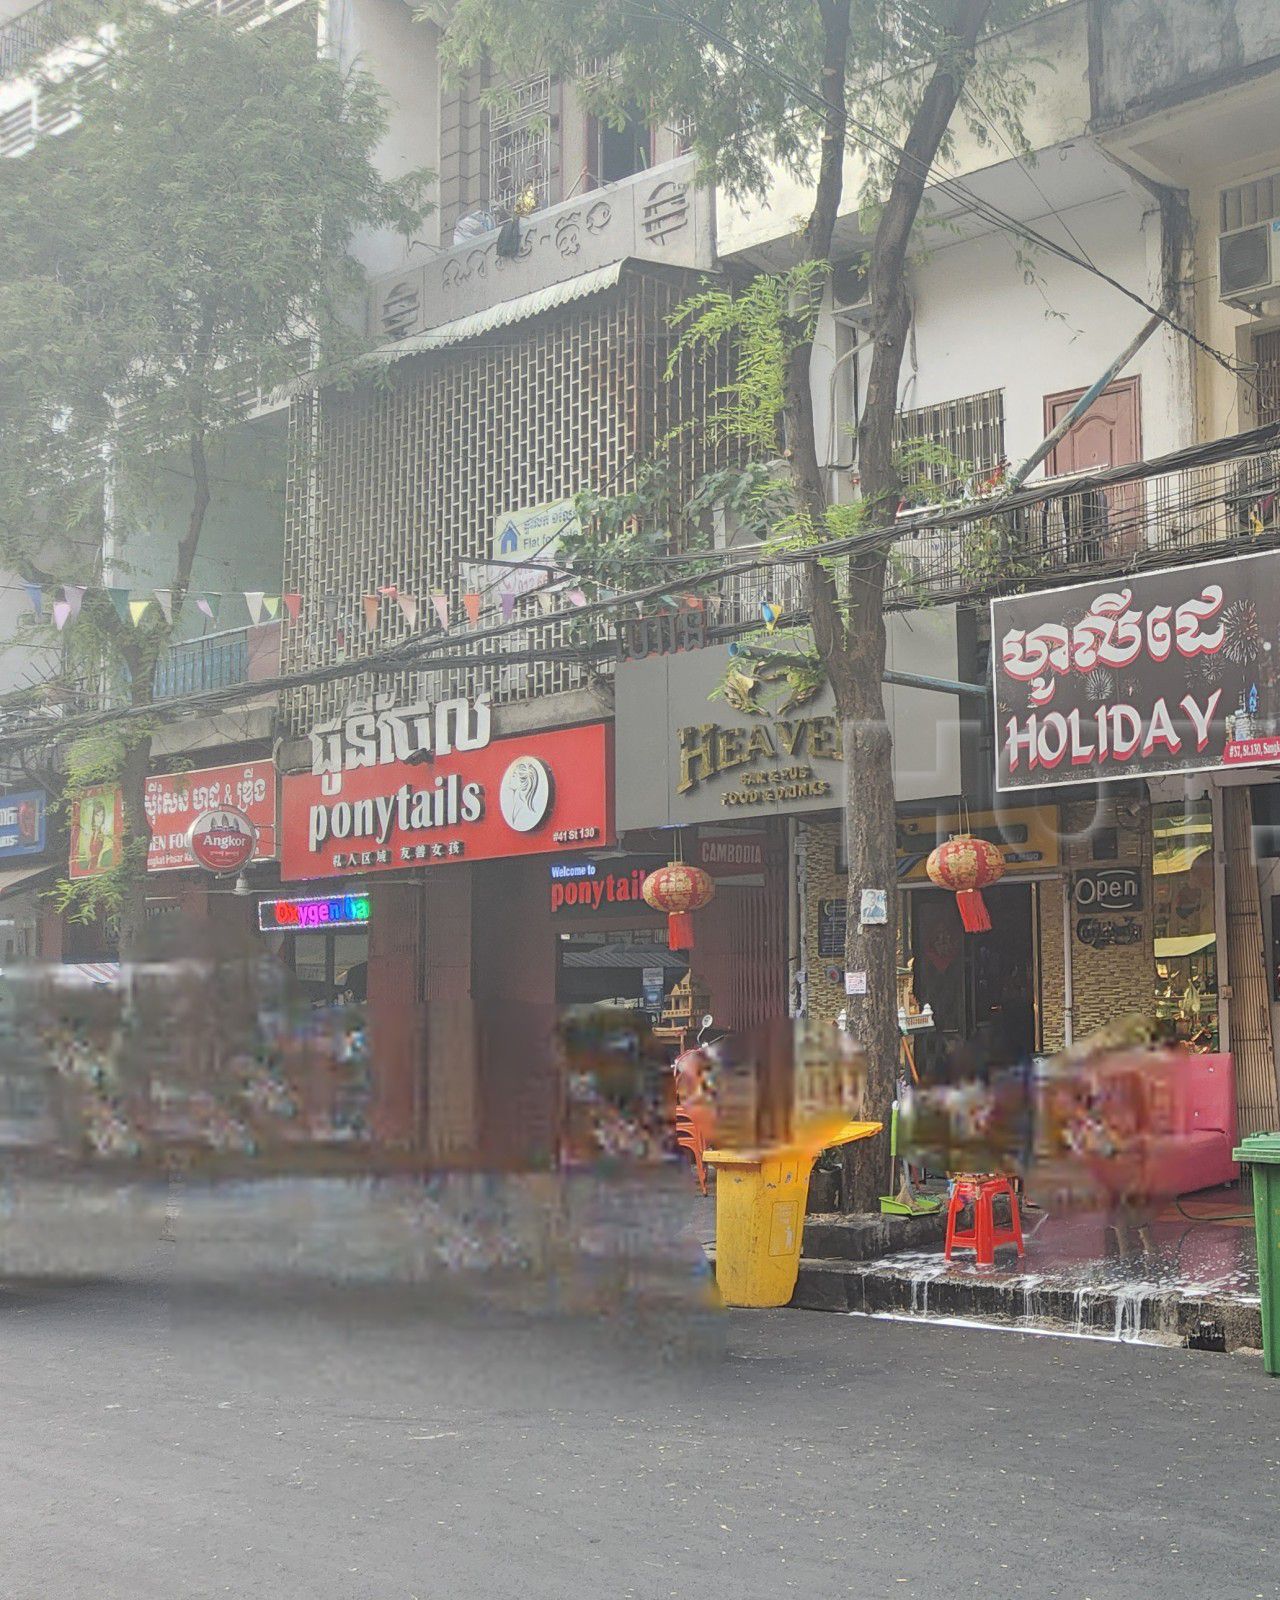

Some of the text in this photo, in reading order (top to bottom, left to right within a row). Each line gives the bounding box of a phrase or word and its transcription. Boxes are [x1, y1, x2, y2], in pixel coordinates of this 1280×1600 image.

[1004, 687, 1222, 773] HOLIDAY
[675, 715, 845, 795] HEAVE
[719, 789, 759, 807] FOOD
[308, 773, 484, 852] ponytails
[203, 835, 245, 849] Angkor
[553, 827, 595, 843] #41 St 130
[400, 840, 465, 860] 友善女孩
[701, 840, 762, 864] CAMBODIA
[551, 863, 596, 878] Welcome to
[1075, 876, 1138, 905] Open
[275, 899, 340, 928] Oxygen
